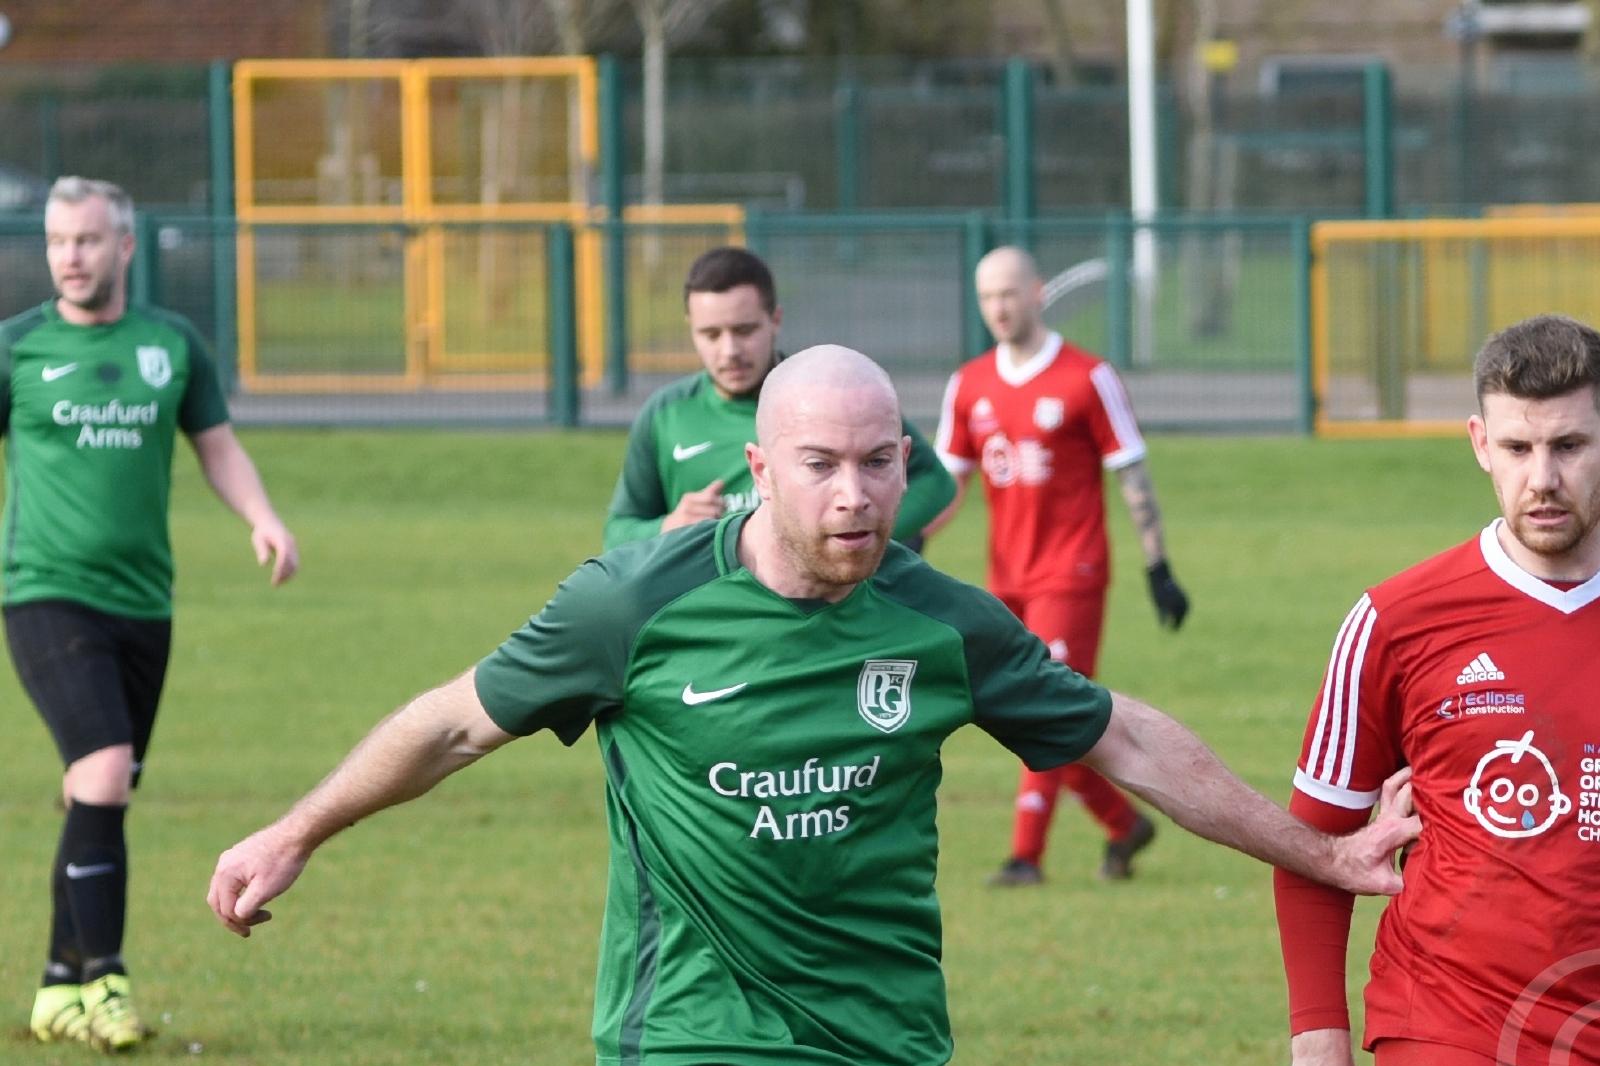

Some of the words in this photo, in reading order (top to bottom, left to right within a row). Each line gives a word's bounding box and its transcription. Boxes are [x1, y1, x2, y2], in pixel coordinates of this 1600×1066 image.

[52, 399, 159, 426] Craufurd
[76, 423, 142, 449] Arms
[1456, 670, 1505, 685] adidas
[1465, 704, 1525, 715] construction
[1584, 744, 1595, 754] IN
[708, 755, 881, 798] Craufurd
[750, 805, 850, 841] Arms
